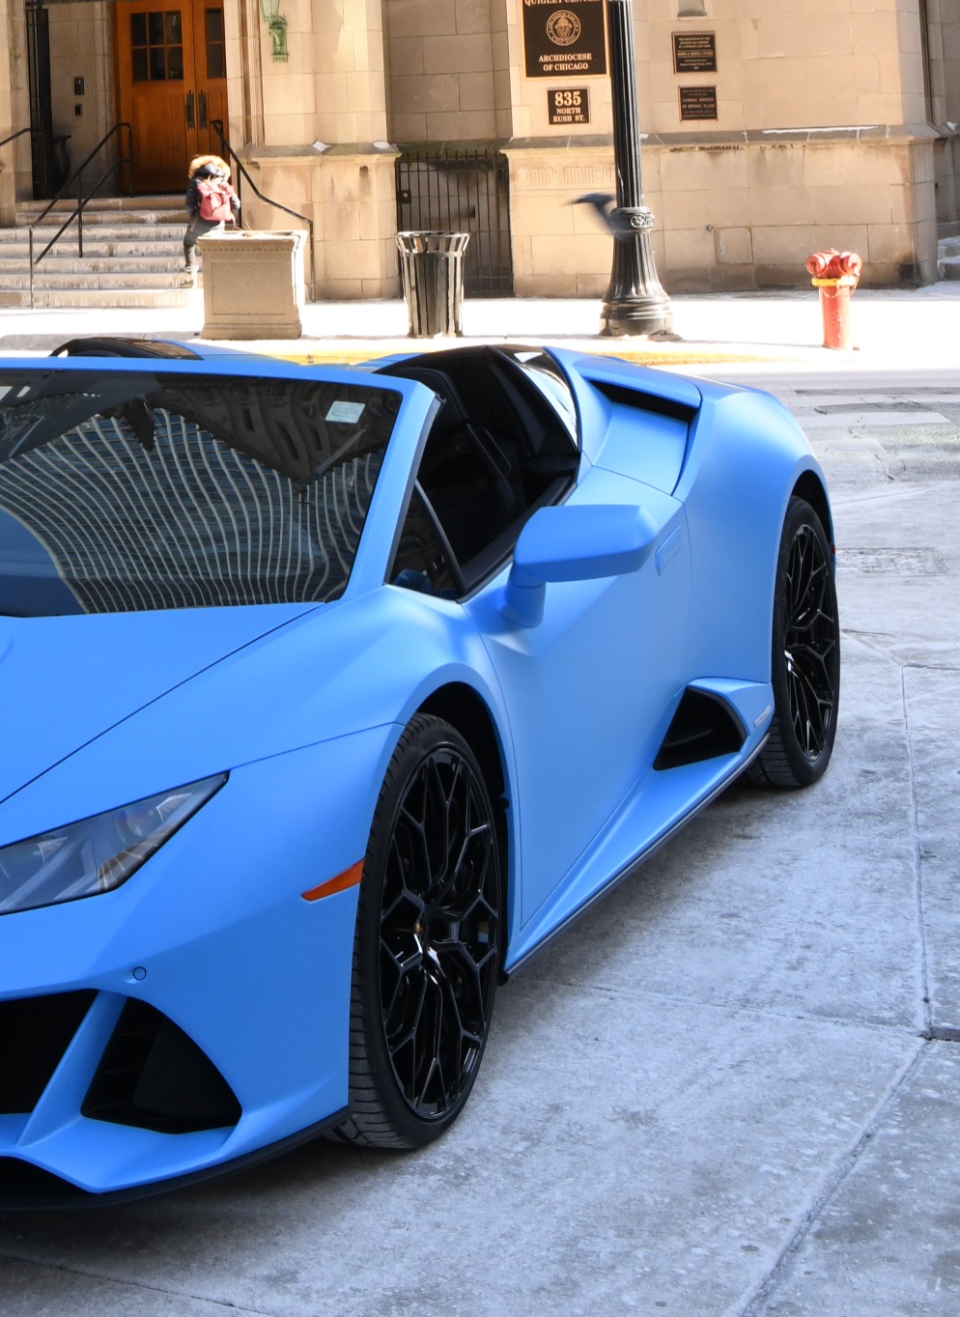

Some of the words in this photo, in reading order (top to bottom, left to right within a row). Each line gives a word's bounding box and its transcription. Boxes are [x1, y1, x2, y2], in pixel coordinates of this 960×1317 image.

[538, 52, 592, 62] ARCHDIOCESE
[542, 63, 554, 72] OF
[554, 62, 589, 72] CHICAGO
[554, 91, 582, 107] 835
[556, 106, 581, 115] NORTH
[552, 115, 572, 123] RUSH
